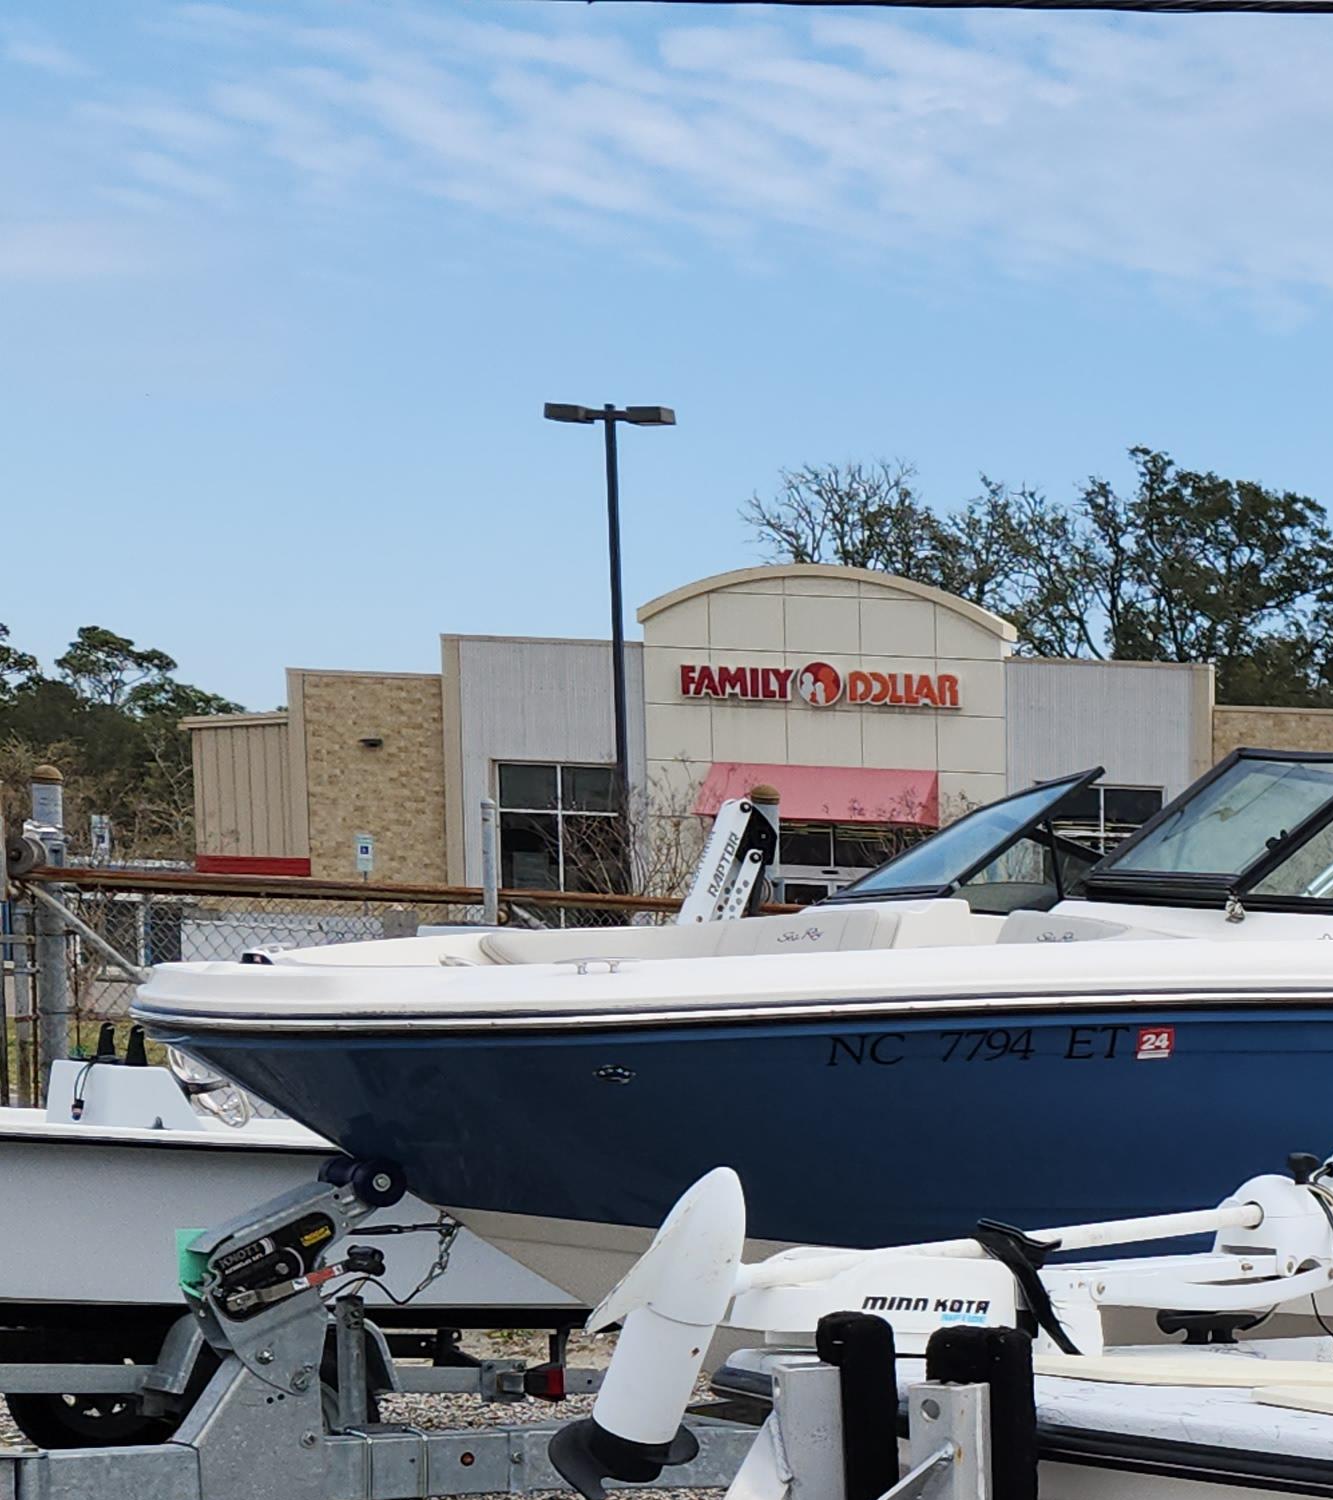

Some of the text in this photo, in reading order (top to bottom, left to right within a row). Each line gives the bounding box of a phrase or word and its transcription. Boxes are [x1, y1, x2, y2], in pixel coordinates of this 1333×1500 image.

[680, 664, 961, 708] FAMILY DOLLAR
[707, 832, 740, 898] RAPTOR
[826, 1025, 1131, 1067] NC 7794 ET
[1140, 1033, 1170, 1050] 24
[933, 1299, 990, 1315] KOTA
